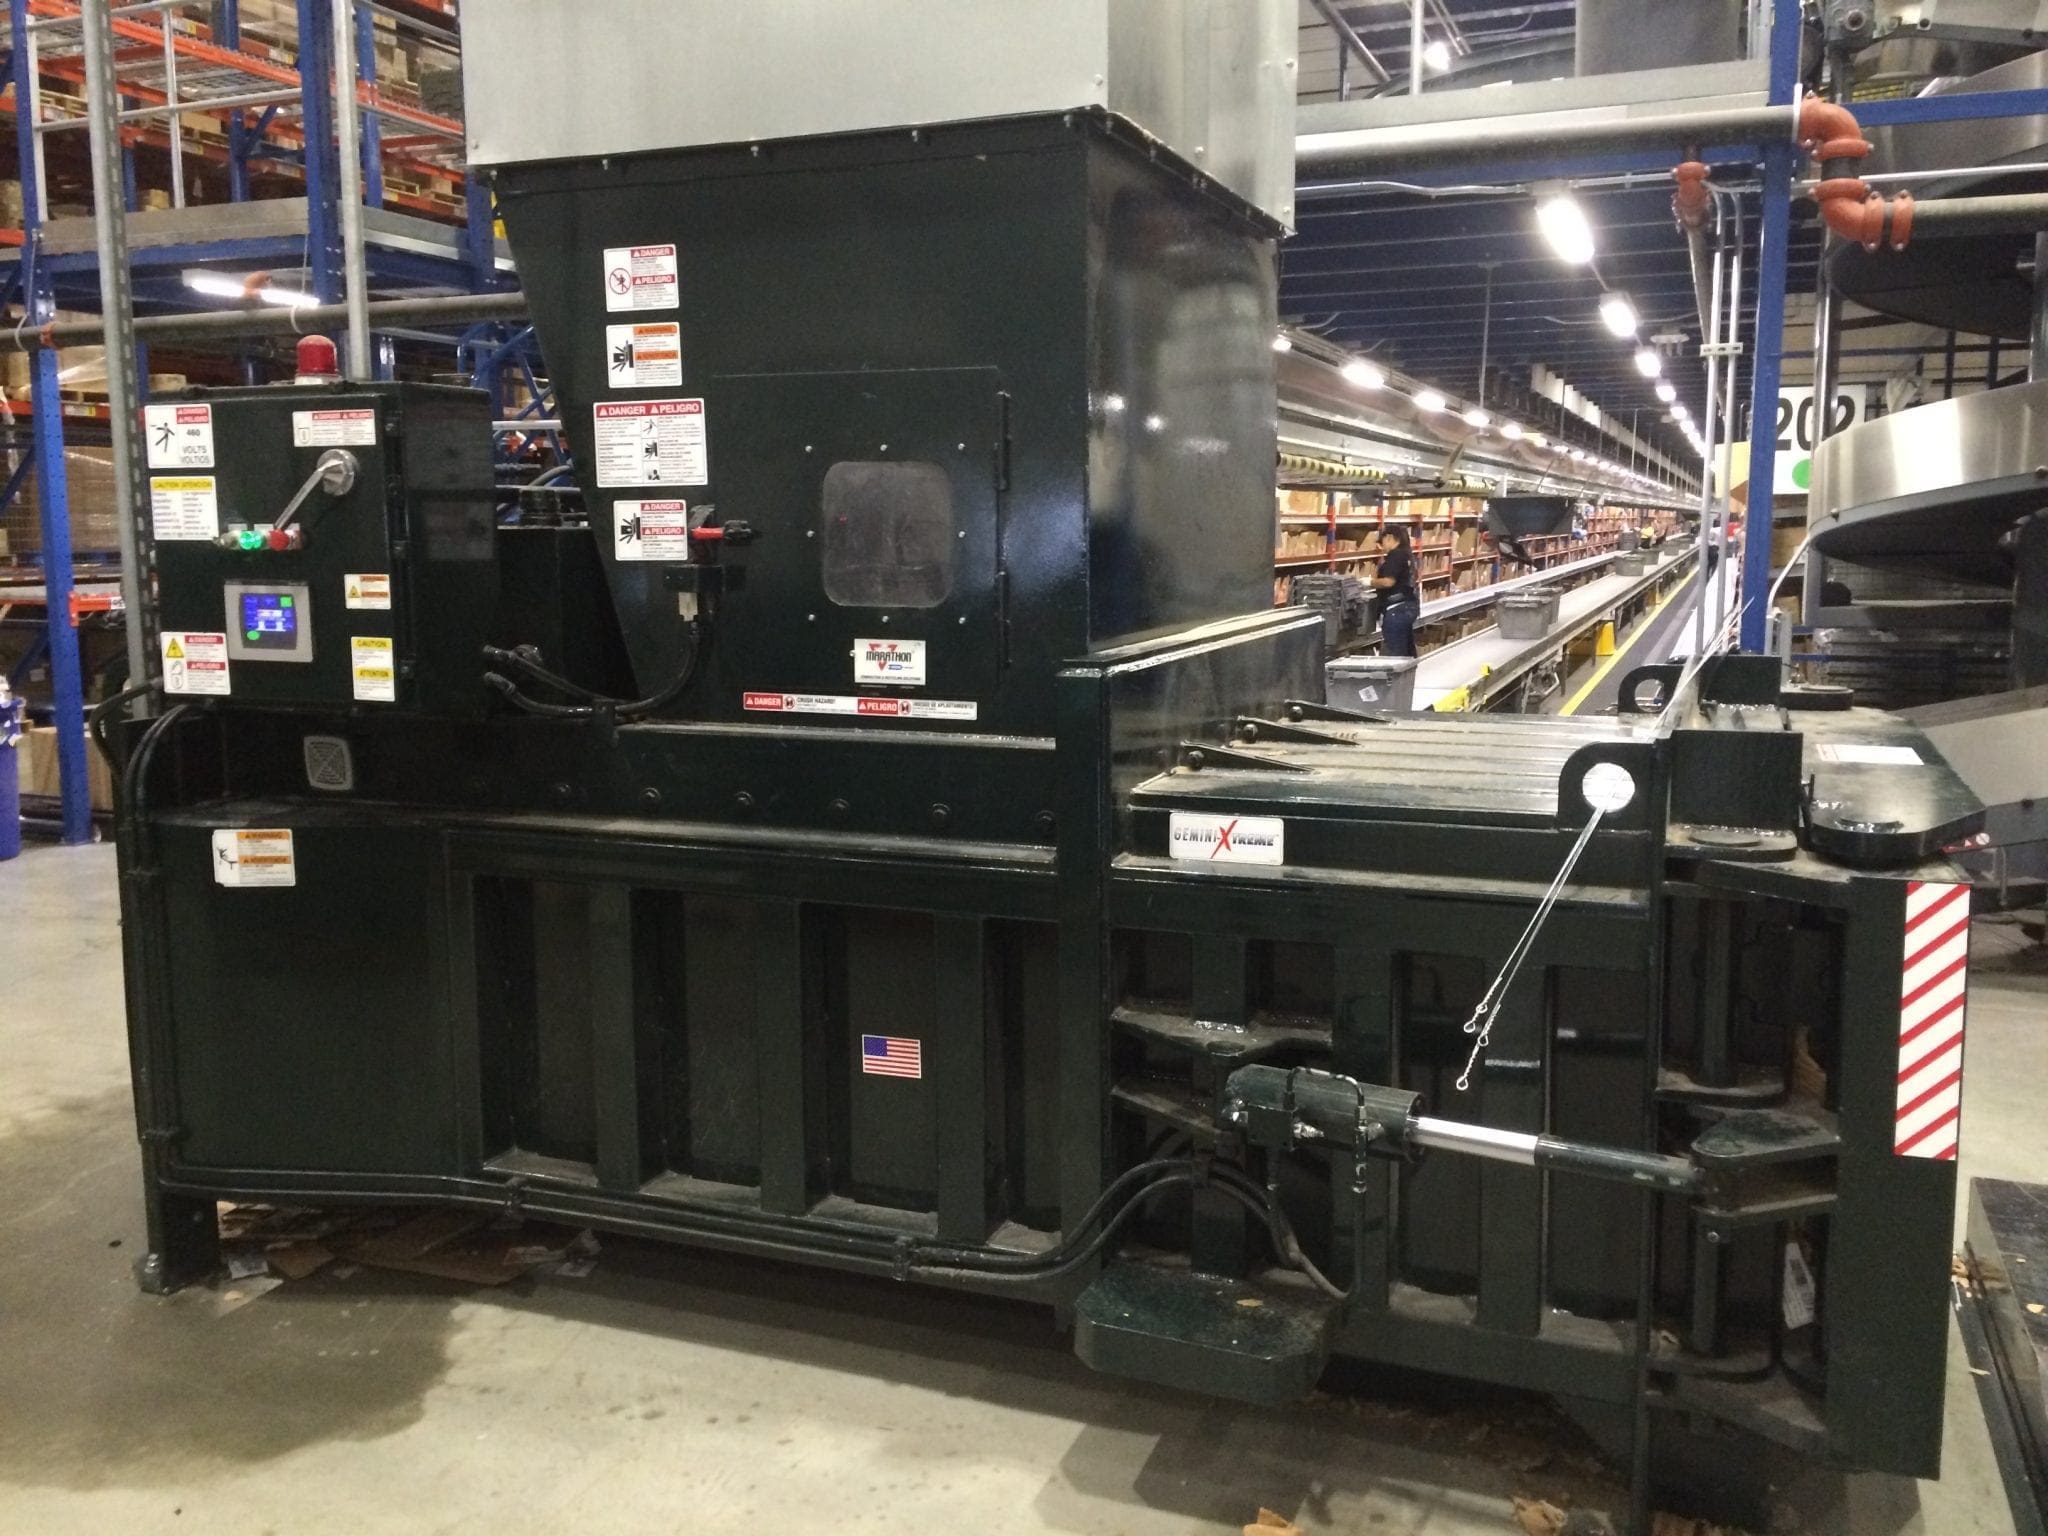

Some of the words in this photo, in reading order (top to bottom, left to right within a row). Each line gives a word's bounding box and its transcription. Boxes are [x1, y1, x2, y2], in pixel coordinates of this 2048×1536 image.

[640, 247, 670, 257] DANGER
[641, 275, 672, 285] PELIGRO
[608, 406, 646, 416] DANGER
[660, 403, 699, 413] PELIGRO
[650, 503, 681, 511] DANGER
[651, 527, 682, 535] PELIGRO
[357, 640, 387, 648] CAUTION
[866, 651, 912, 662] MARATHON
[754, 697, 781, 706] DANGER
[867, 702, 897, 712] PELIGRO
